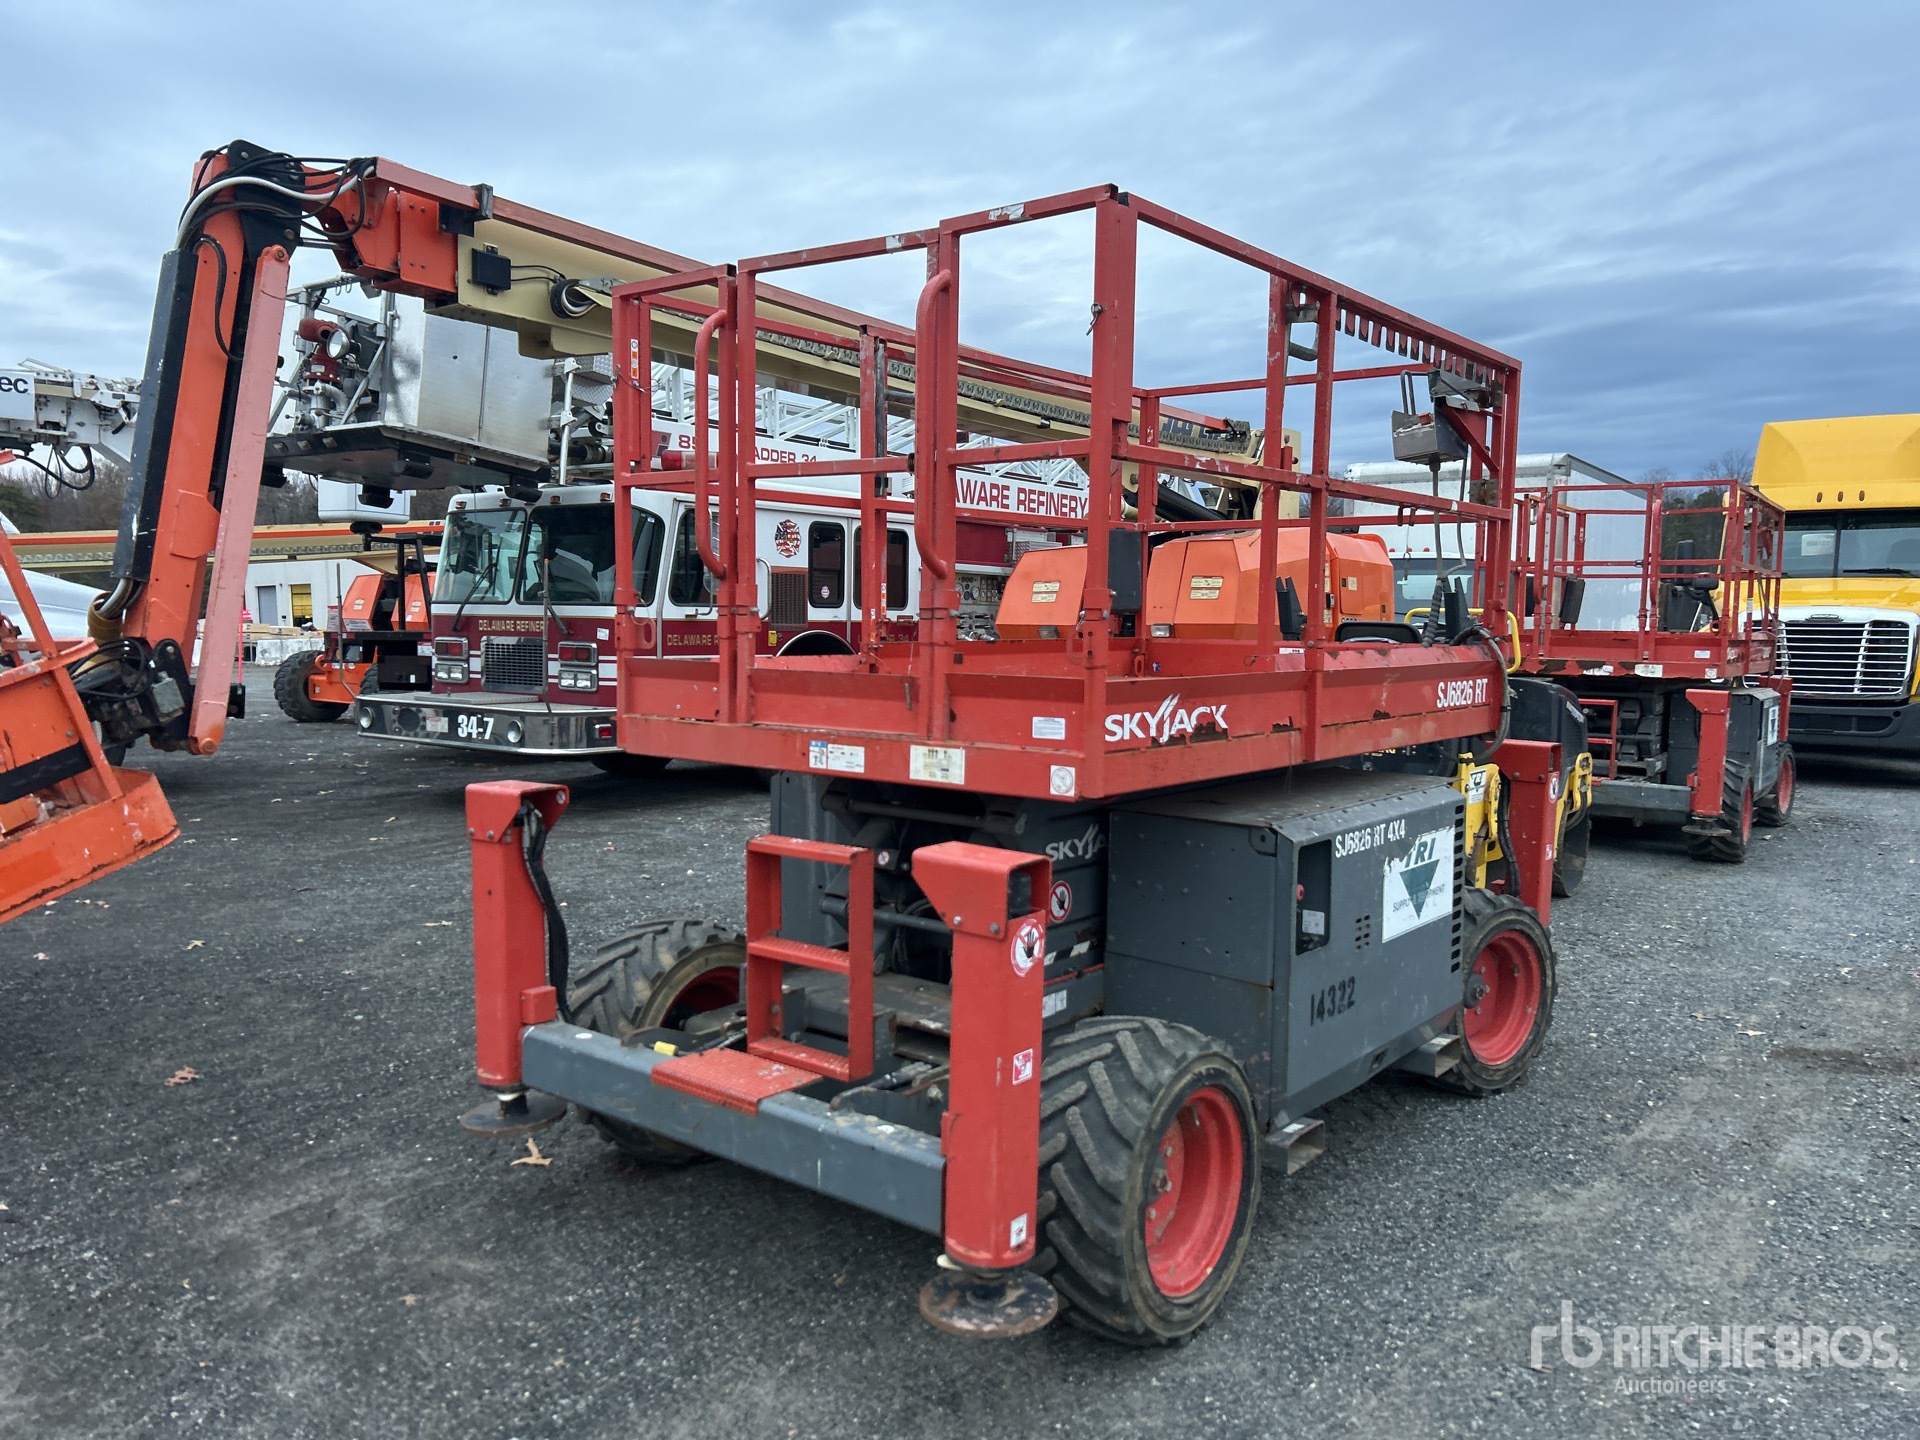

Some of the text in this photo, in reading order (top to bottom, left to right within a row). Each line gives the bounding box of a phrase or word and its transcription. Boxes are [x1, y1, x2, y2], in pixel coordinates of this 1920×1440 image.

[754, 447, 796, 463] ADDER
[957, 477, 1088, 519] WARE REFINERY
[478, 619, 549, 632] DELAWARE REFINER
[666, 634, 712, 646] DELAWARE
[1436, 678, 1489, 709] SJ6826 RT
[457, 714, 495, 740] 34-7
[1104, 692, 1230, 744] SKYJACK
[1045, 823, 1106, 861] SKYJA
[1335, 818, 1406, 859] SJ6826 RT 4X4
[1309, 975, 1356, 1027] 14322
